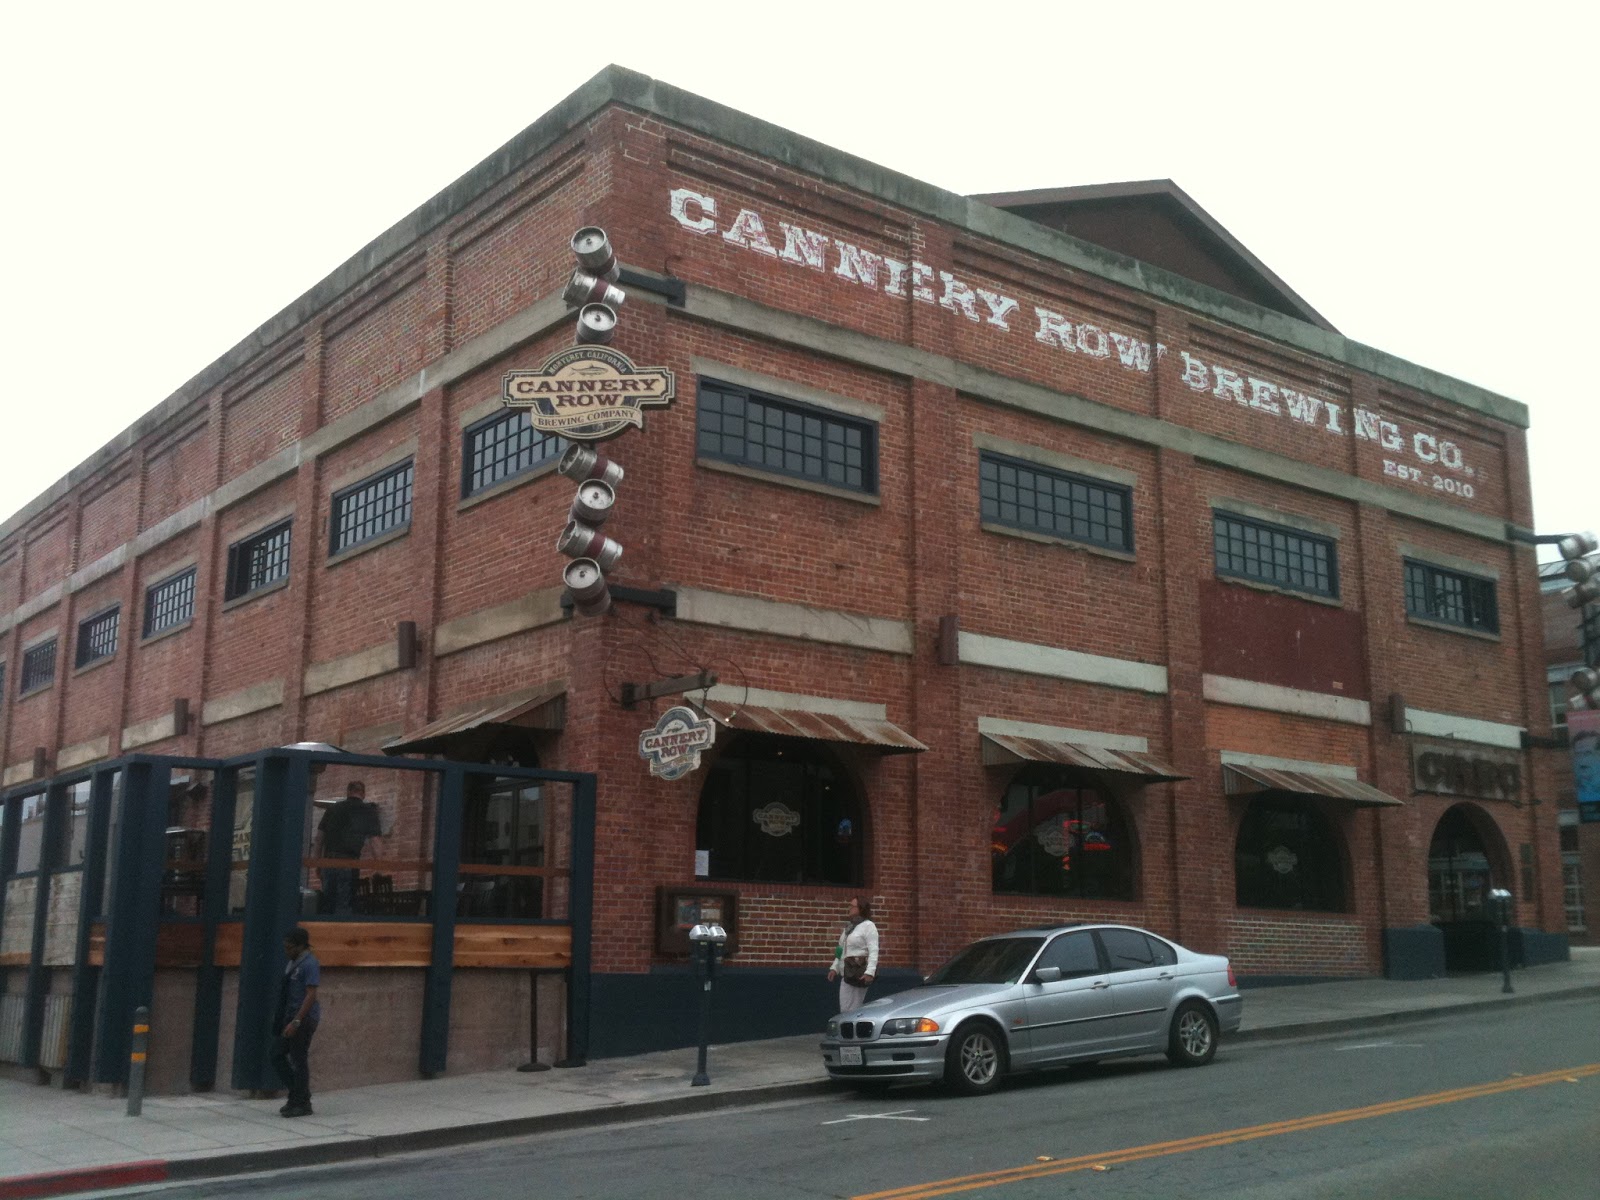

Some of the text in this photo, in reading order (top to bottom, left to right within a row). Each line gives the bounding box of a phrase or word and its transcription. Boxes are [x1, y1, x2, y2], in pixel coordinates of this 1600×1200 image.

[669, 188, 1020, 331] CANNERY
[1034, 306, 1168, 375] ROW
[1180, 350, 1405, 454] BREWING
[547, 351, 628, 374] MONTEREY CALIFORNIA
[516, 378, 660, 394] CANNERY
[555, 394, 622, 407] ROW
[538, 409, 635, 427] BREWING COMPANY
[1382, 458, 1475, 499] EST. 2010
[644, 728, 706, 749] CANNERY
[660, 744, 690, 758] ROW
